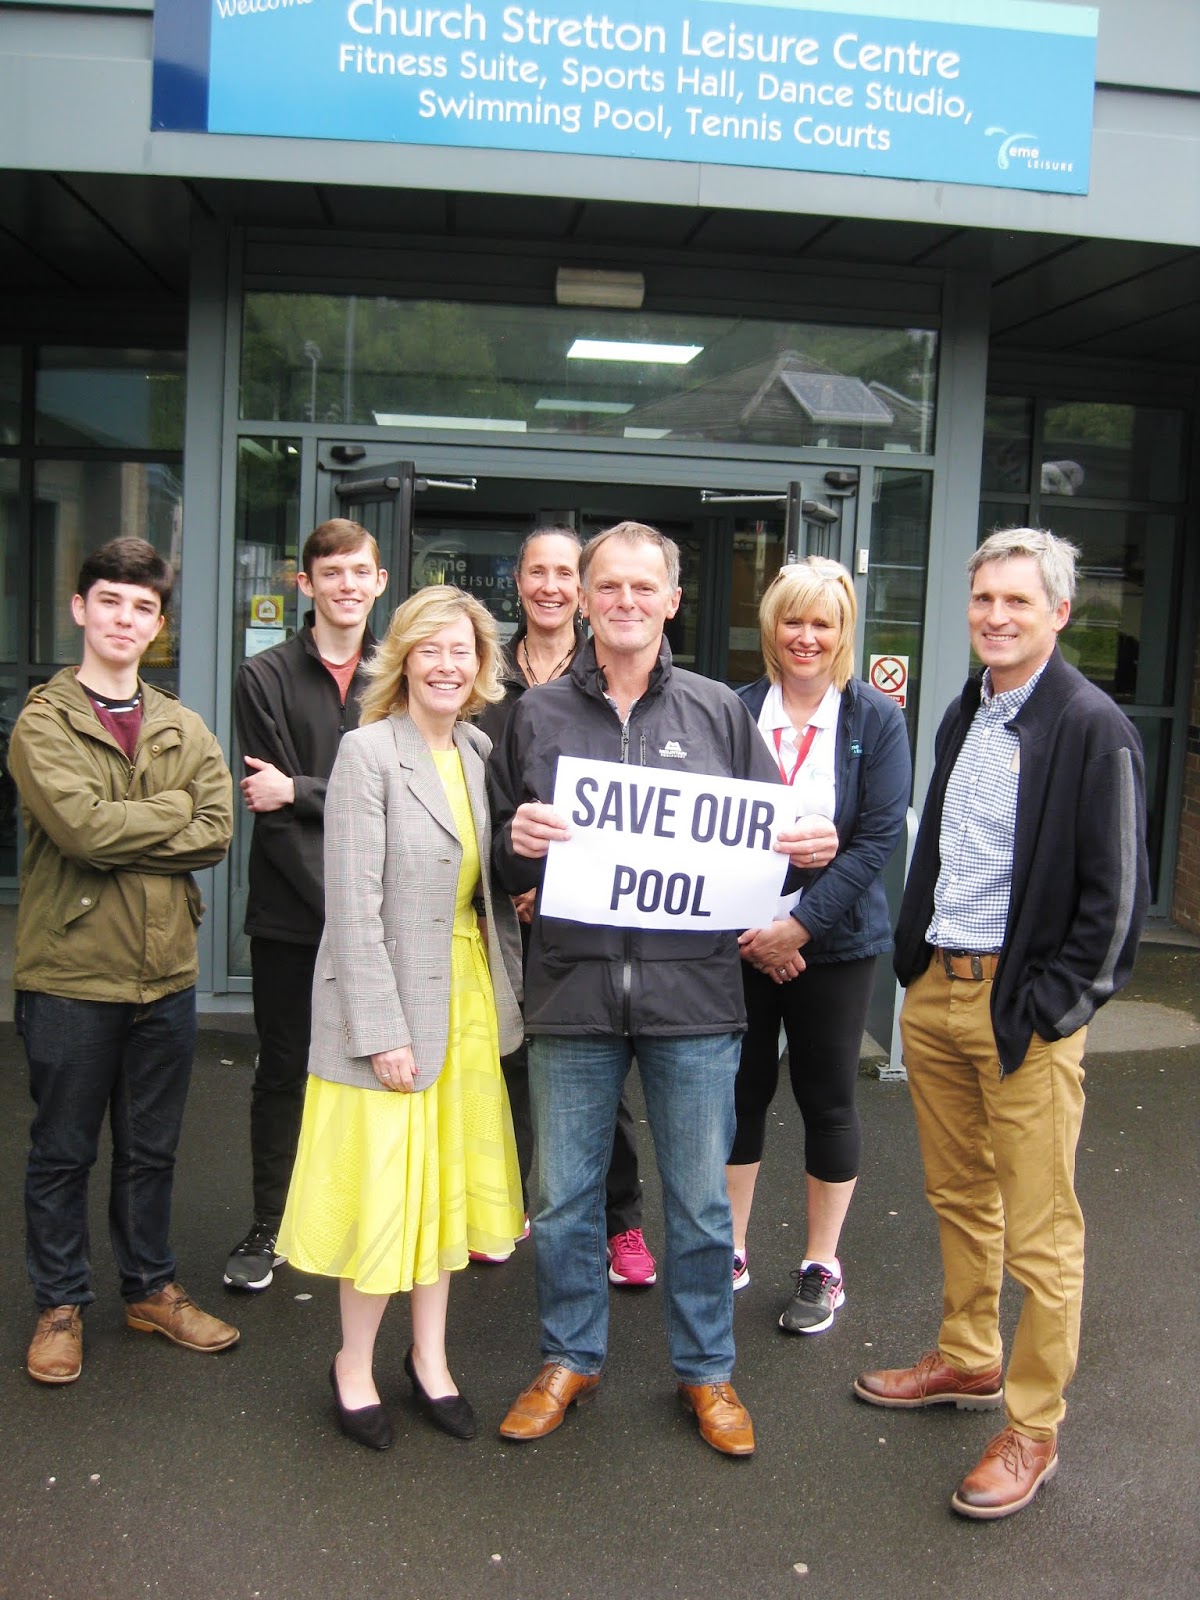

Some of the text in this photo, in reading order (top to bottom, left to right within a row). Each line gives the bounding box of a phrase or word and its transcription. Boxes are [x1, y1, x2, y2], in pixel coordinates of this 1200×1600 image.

[216, 0, 313, 19] Welcom
[347, 0, 961, 80] Church Stretton Leisure Centre
[338, 42, 973, 125] Fitness Suite, Sports Hall, Dance Studio,
[418, 88, 891, 151] Swimming Pool, Tennis Courts
[1027, 159, 1073, 172] LEISURE
[452, 575, 514, 589] LEISURE
[572, 777, 775, 851] SAVE OUR
[610, 864, 711, 917] POOL
